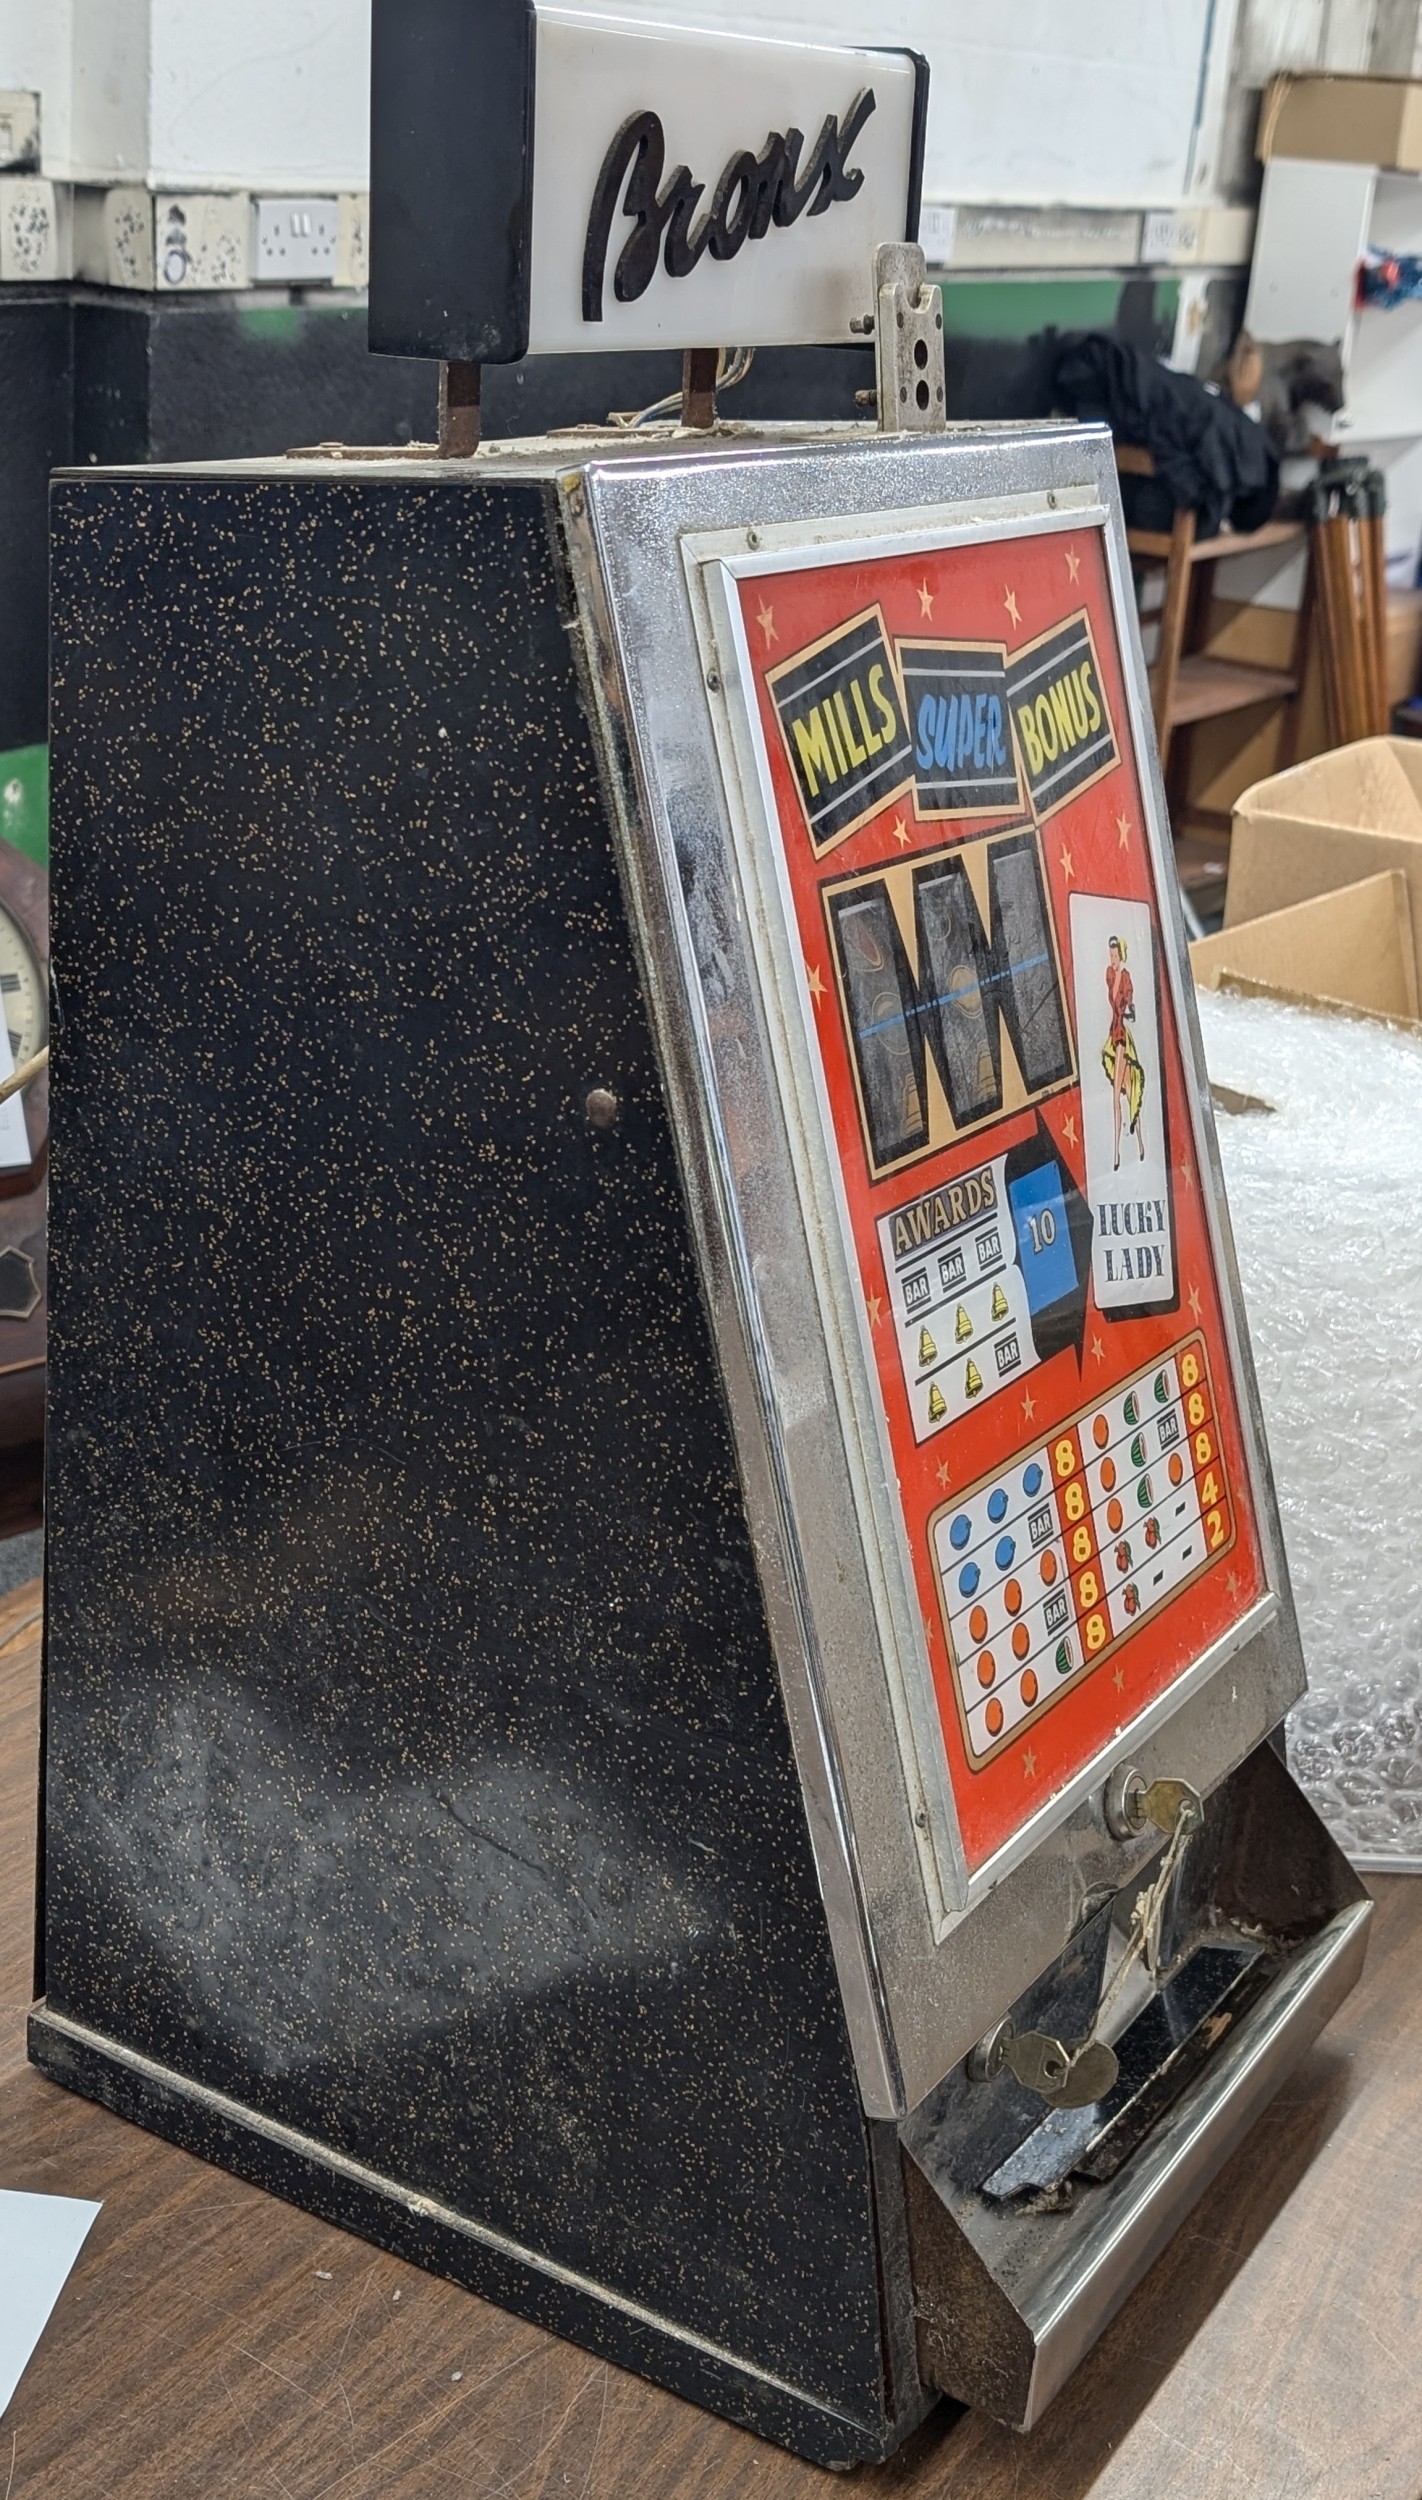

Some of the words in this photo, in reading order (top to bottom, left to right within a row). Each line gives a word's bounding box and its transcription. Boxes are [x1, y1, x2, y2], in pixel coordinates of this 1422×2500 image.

[582, 87, 876, 322] Bronx
[792, 663, 896, 797] MILLS
[915, 692, 1007, 772] SUPER
[1017, 660, 1101, 776] BONUS
[894, 1168, 996, 1256] AWARDS
[1029, 1207, 1056, 1254] 10
[1097, 1199, 1166, 1237] LUCKY
[905, 1278, 929, 1306] BAR
[941, 1258, 964, 1284] BAR
[977, 1237, 1000, 1262] BAR
[1104, 1244, 1165, 1283] LADY
[997, 1343, 1019, 1367] BAR
[1181, 1353, 1199, 1387] 8
[1159, 1417, 1178, 1441] BAR
[1188, 1392, 1205, 1426] 8
[1055, 1439, 1075, 1477] 8
[1195, 1432, 1212, 1464] 8
[1201, 1471, 1219, 1505] 4
[1030, 1516, 1053, 1540] BAR
[1065, 1482, 1085, 1521] 8
[1207, 1510, 1224, 1548] 2
[1072, 1526, 1092, 1563] 8
[1046, 1600, 1068, 1627] BAR
[1079, 1571, 1099, 1608] 8
[1086, 1613, 1106, 1651] 8
